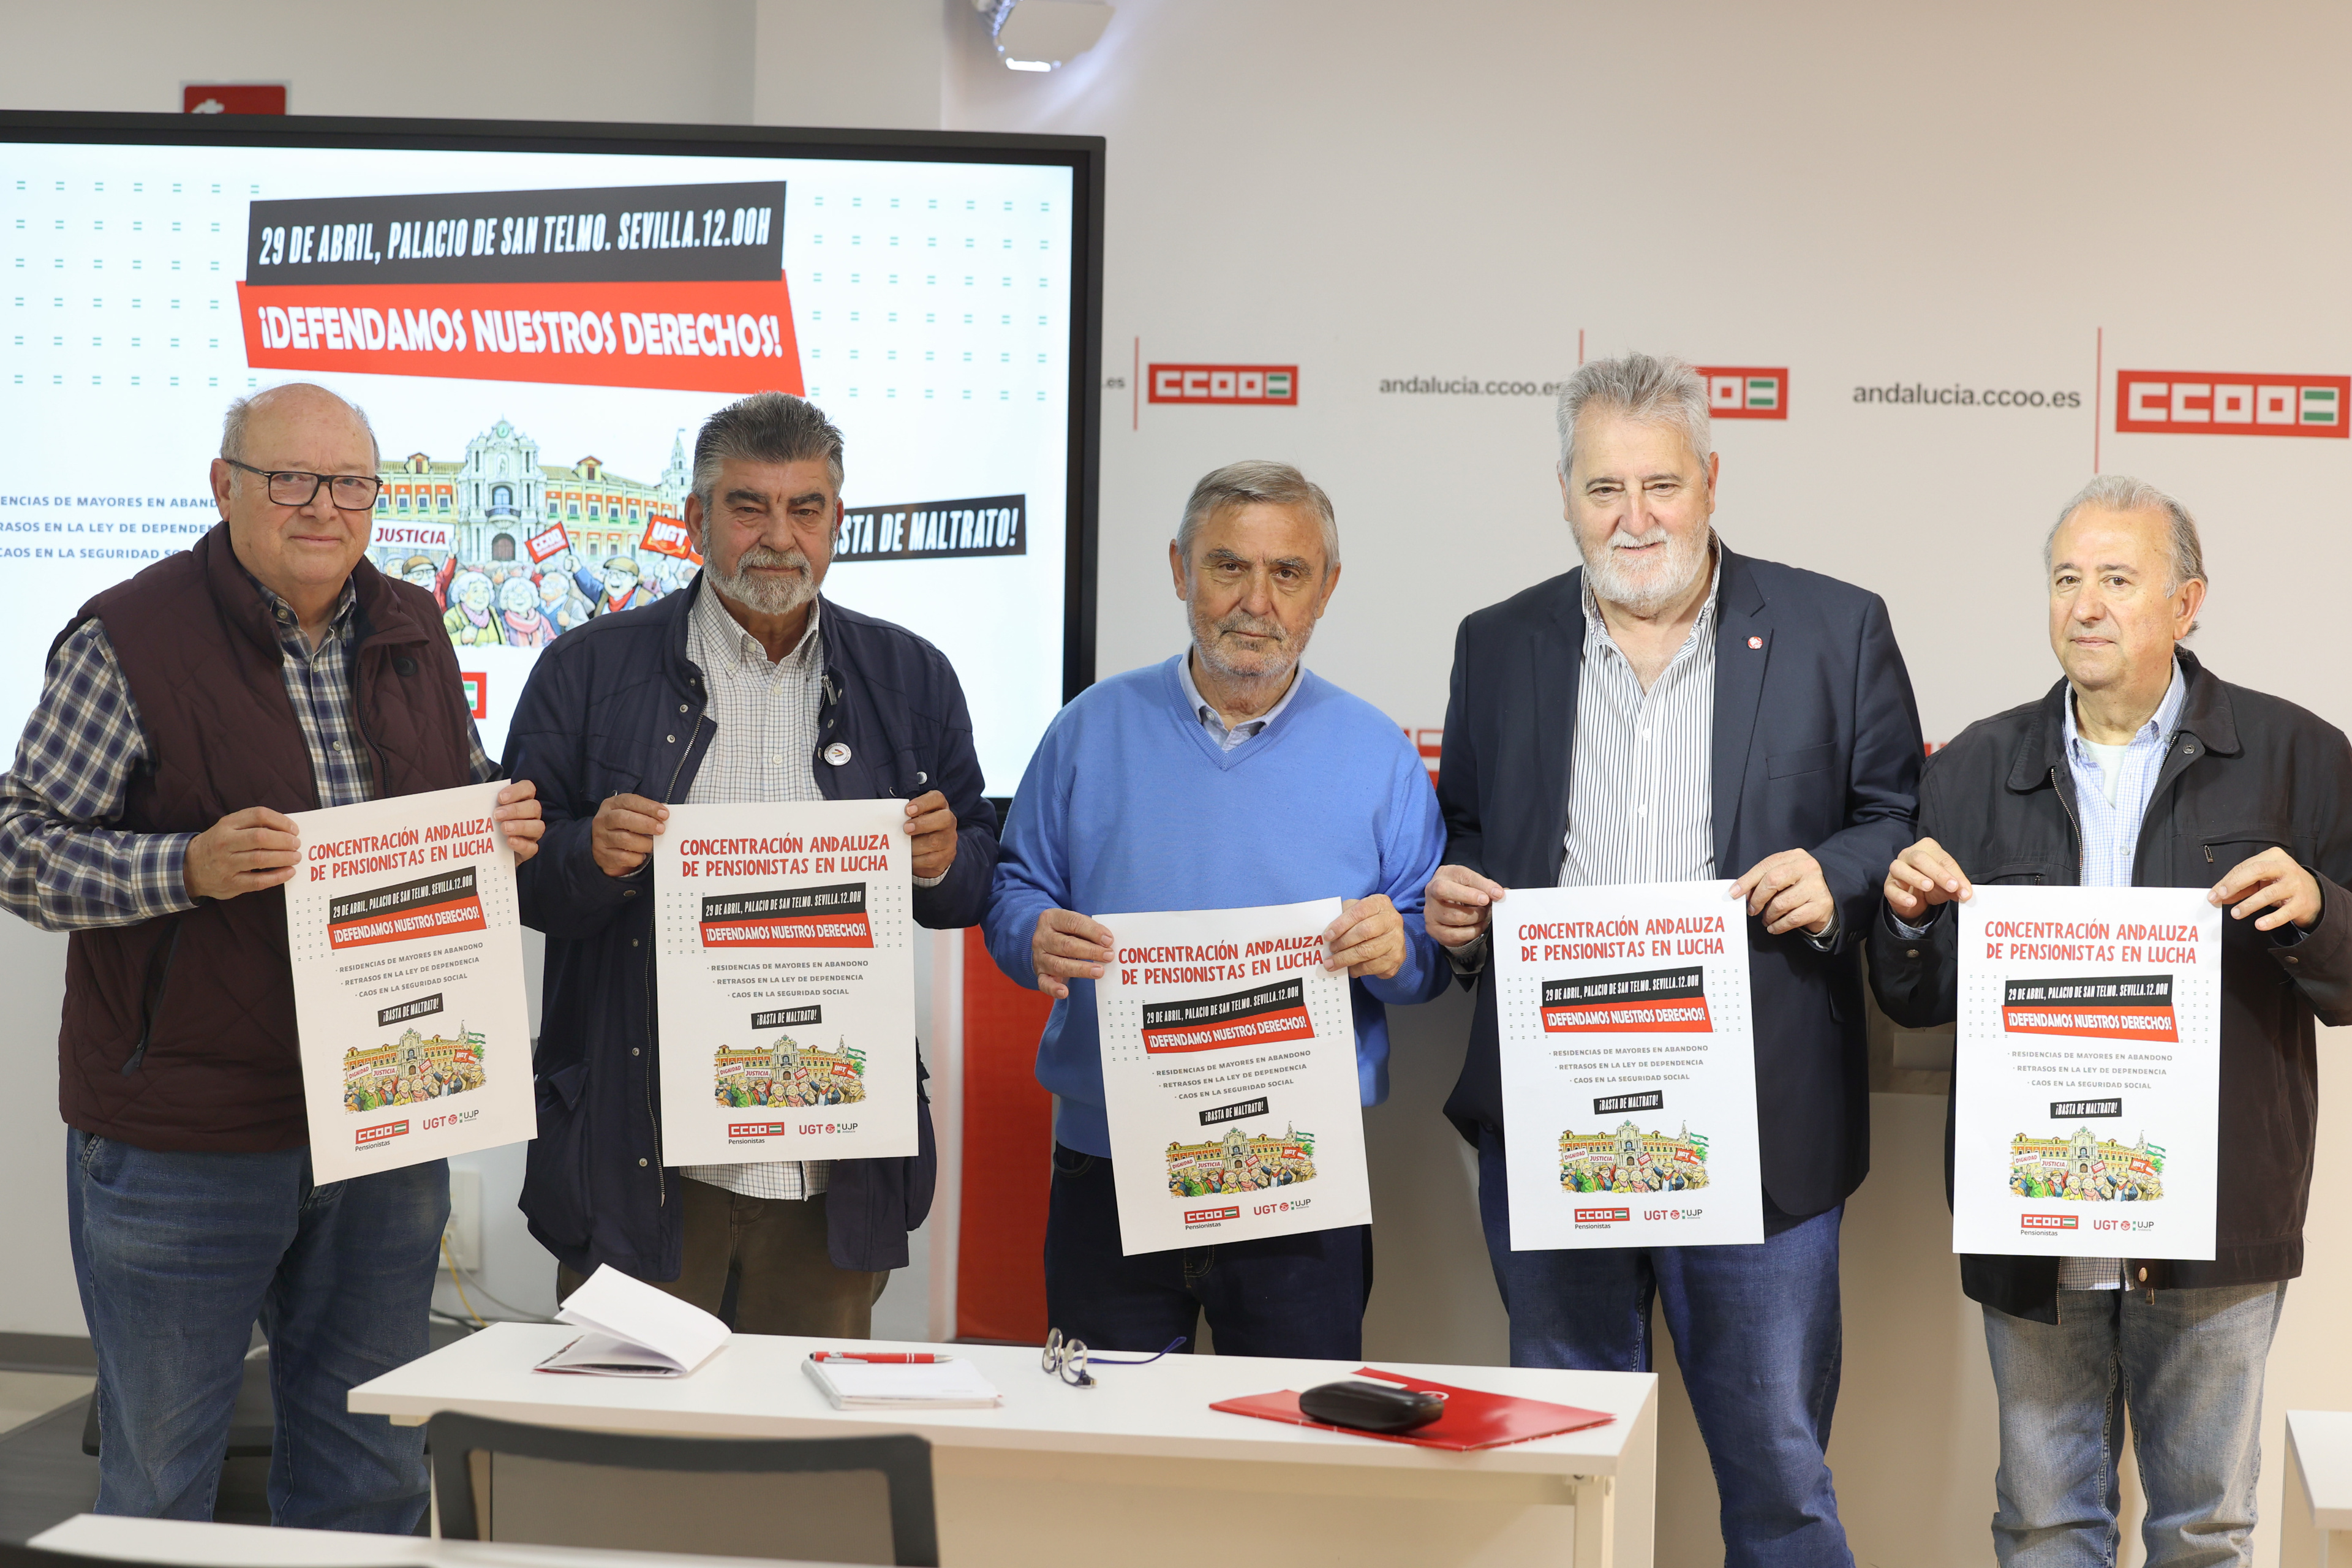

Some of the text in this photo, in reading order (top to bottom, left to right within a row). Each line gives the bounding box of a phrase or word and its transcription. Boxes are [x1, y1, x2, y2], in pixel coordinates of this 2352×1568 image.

[259, 207, 771, 265] 29 DE ABRIL, PALACIO DE SAN TELMO. SEVILLA.12.00H
[258, 306, 782, 358] ¡DEFENDAMOS NUESTROS DERECHOS!
[1853, 382, 2081, 409] andalucia.ccoo.es
[55, 497, 71, 506] DE
[77, 497, 142, 507] MAYORES
[148, 498, 165, 507] EN
[45, 523, 62, 532] EN
[68, 523, 84, 532] LA
[89, 524, 113, 532] LEY
[119, 524, 135, 532] DE
[375, 527, 447, 545] JUSTICIA
[651, 521, 688, 547] UGT
[834, 508, 1019, 555] STA DE MALTRATO!
[36, 549, 53, 557] EN
[59, 549, 75, 557] LA
[80, 549, 160, 558] SEGURIDAD
[309, 817, 496, 861] CONCENTRACIÓN ANDALUZA
[680, 832, 889, 856] CONCENTRACIÓN ANDALUZA
[311, 837, 494, 882] DE PENSIONISTAS EN LUCHA
[682, 855, 888, 877] DE PENSIONISTAS EN LUCHA
[706, 905, 714, 916] 29
[715, 904, 722, 916] DE
[723, 902, 742, 914] ABRIL,
[745, 899, 769, 913] PALACIO
[770, 899, 778, 910] DE
[779, 898, 790, 910] SAN
[792, 895, 813, 908] TELMO.
[334, 906, 480, 943] ¡DEFENDAMOS NUESTROS DERECHOS!
[706, 923, 867, 941] ¡DEFENDAMOS NUESTROS DERECHOS!
[1518, 915, 1725, 940] CONCENTRACIÓN ANDALUZA
[1985, 918, 2198, 942] CONCENTRACIÓN ANDALUZA
[339, 960, 385, 973] RESIDENCIAS
[399, 952, 431, 962] MAYORES
[444, 942, 483, 954] ABANDONO
[1118, 935, 1324, 964] CONCENTRACIÓN ANDALUZA
[1521, 938, 1724, 962] DE PENSIONISTAS EN LUCHA
[1986, 943, 2196, 963] DE PENSIONISTAS EN LUCHA
[345, 974, 381, 986] RETRASOS
[431, 957, 480, 970] DEPENDENCIA
[1121, 949, 1324, 985] DE PENSIONISTAS EN LUCHA
[402, 978, 442, 990] SEGURIDAD
[443, 973, 467, 982] SOCIAL
[1546, 989, 1553, 1001] 29
[1555, 988, 1562, 1000] DE
[1563, 987, 1582, 999] ABRIL,
[1584, 984, 1608, 997] PALACIO
[1609, 982, 1616, 995] DE
[1618, 981, 1629, 994] SAN
[1630, 979, 1651, 992] TELMO.
[383, 998, 439, 1022] ¡BASTA DE MALTRATO!
[757, 1009, 816, 1025] ¡BASTA DE MALTRATO!
[1547, 1008, 1706, 1026] ¡DEFENDAMOS NUESTROS DERECHOS!
[2008, 1012, 2172, 1030] ¡DEFENDAMOS NUESTROS DERECHOS!
[1148, 1016, 1307, 1047] ¡DEFENDAMOS NUESTROS DERECHOS!
[349, 1066, 369, 1079] DIGNIDAD
[373, 1068, 395, 1077] JUSTICIA
[720, 1066, 742, 1075] DIGNIDAD
[834, 1064, 846, 1072] UGT
[1205, 1101, 1264, 1122] ¡BASTA DE MALTRATO!
[1599, 1095, 1658, 1110] ¡BASTA DE MALTRATO!
[2056, 1102, 2117, 1115] ¡BASTA DE MALTRATO!
[423, 1116, 447, 1130] UGT
[464, 1110, 480, 1120] UJP
[355, 1140, 391, 1152] Pensionistas
[1564, 1150, 1585, 1160] DIGNIDAD
[1253, 1204, 1277, 1215] UGT
[2094, 1219, 2118, 1231] UGT
